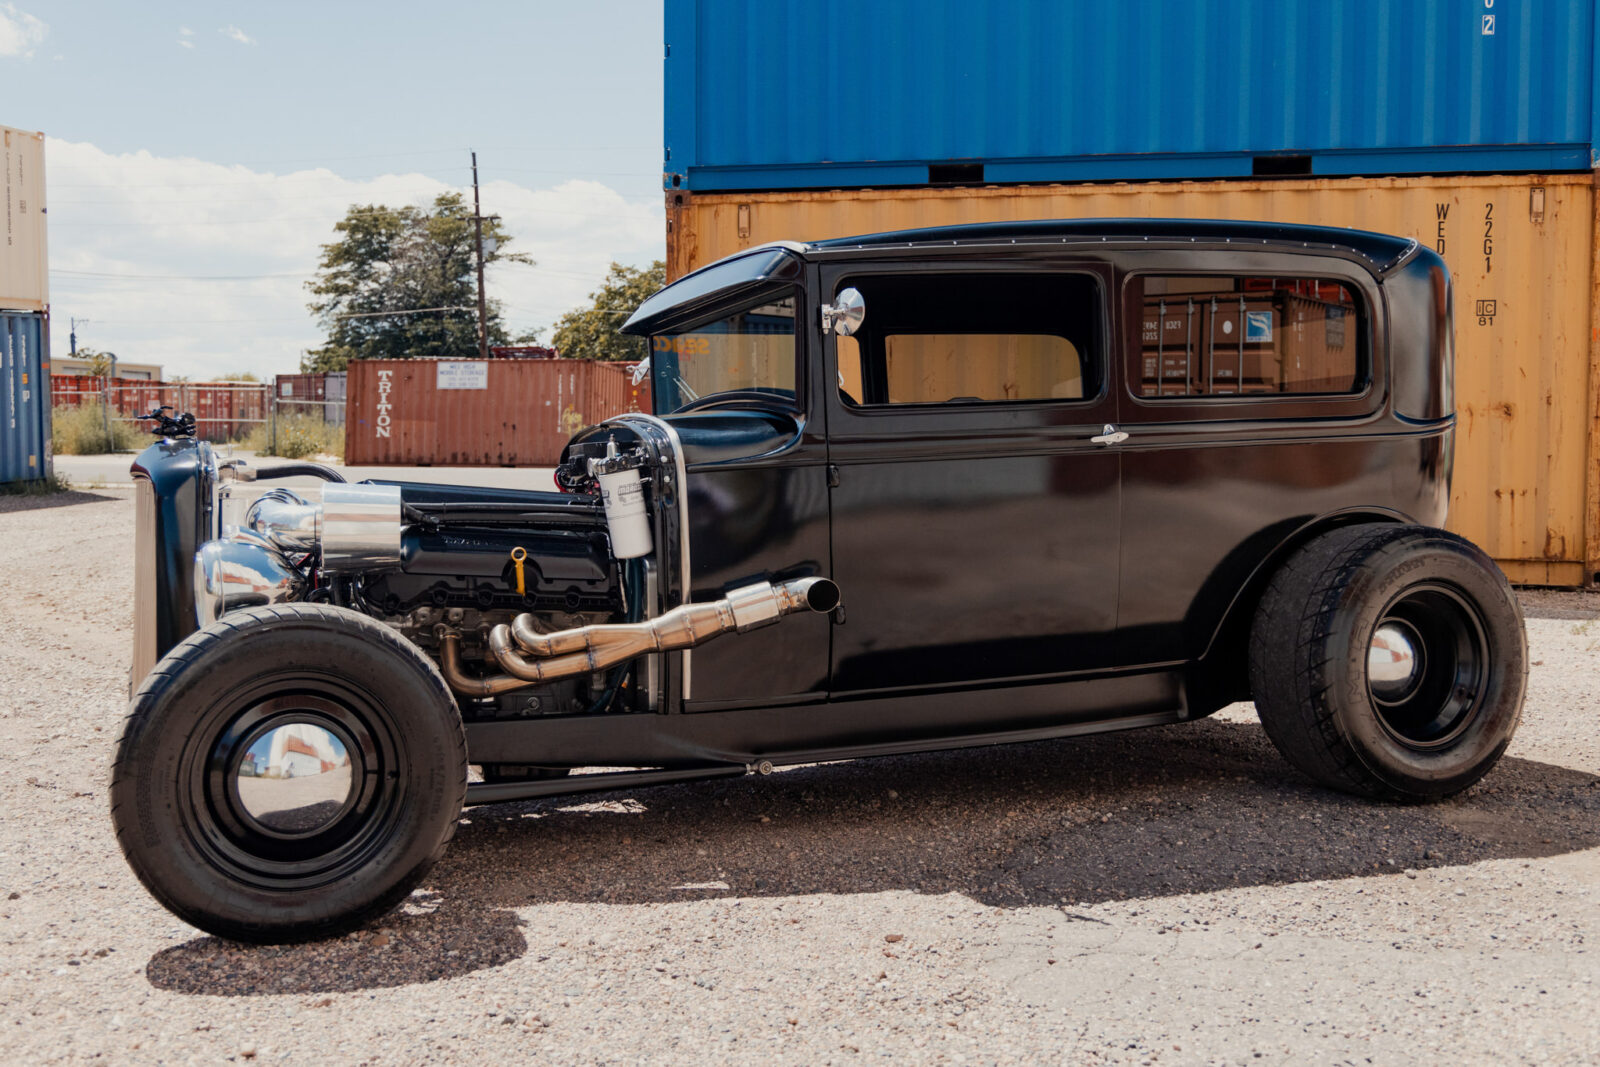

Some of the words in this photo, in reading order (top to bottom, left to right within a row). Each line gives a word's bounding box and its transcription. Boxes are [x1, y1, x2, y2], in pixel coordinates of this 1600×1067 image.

[1483, 203, 1493, 273] 22G1
[1478, 317, 1493, 326] 81
[376, 370, 393, 438] TRITON
